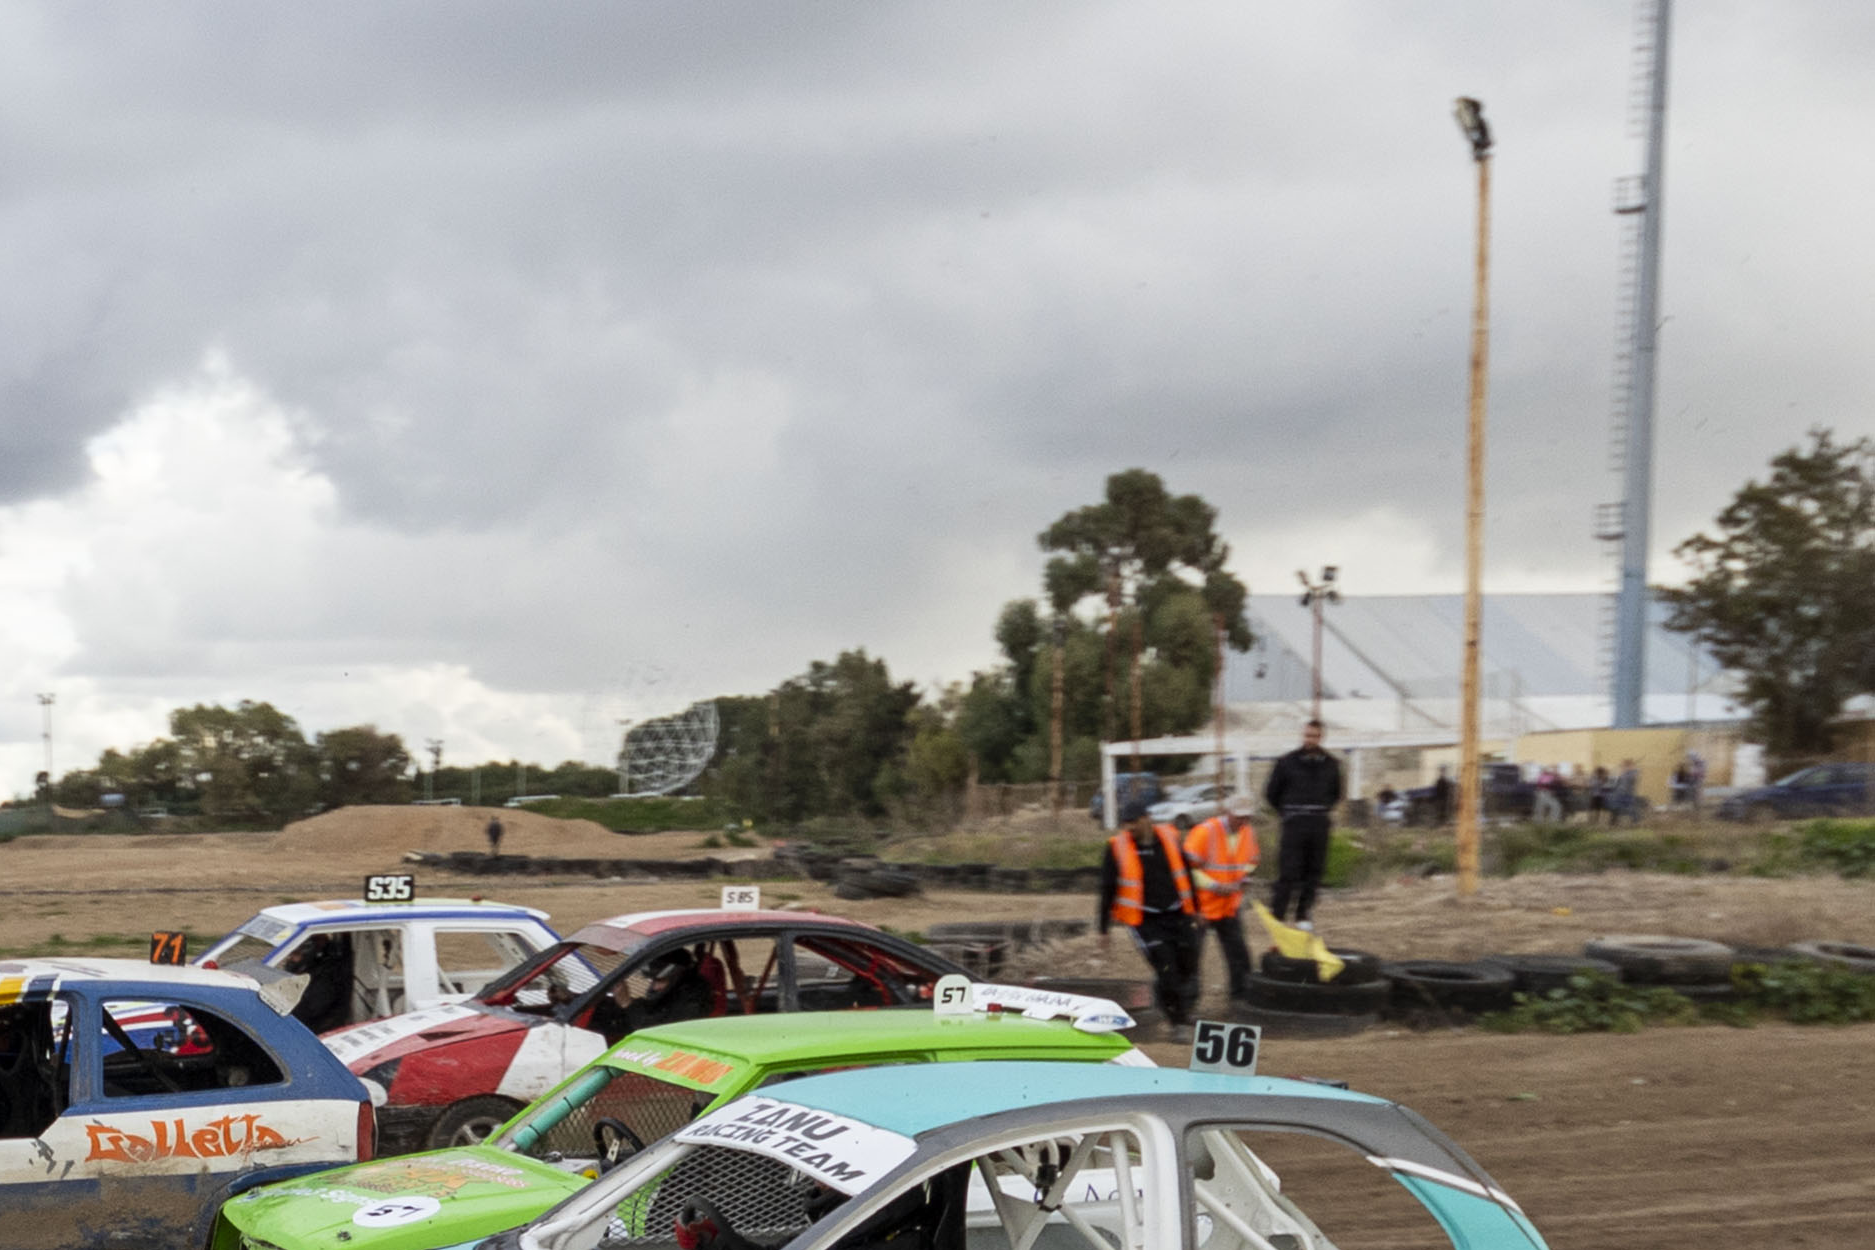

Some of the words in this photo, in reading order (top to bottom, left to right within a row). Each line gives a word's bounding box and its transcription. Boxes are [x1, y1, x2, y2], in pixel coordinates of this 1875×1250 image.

[153, 933, 183, 963] 71
[941, 986, 966, 1004] 57
[1195, 1023, 1257, 1068] 56
[734, 1104, 850, 1142] ZANU
[686, 1125, 778, 1144] RACING
[772, 1136, 867, 1182] TEAM
